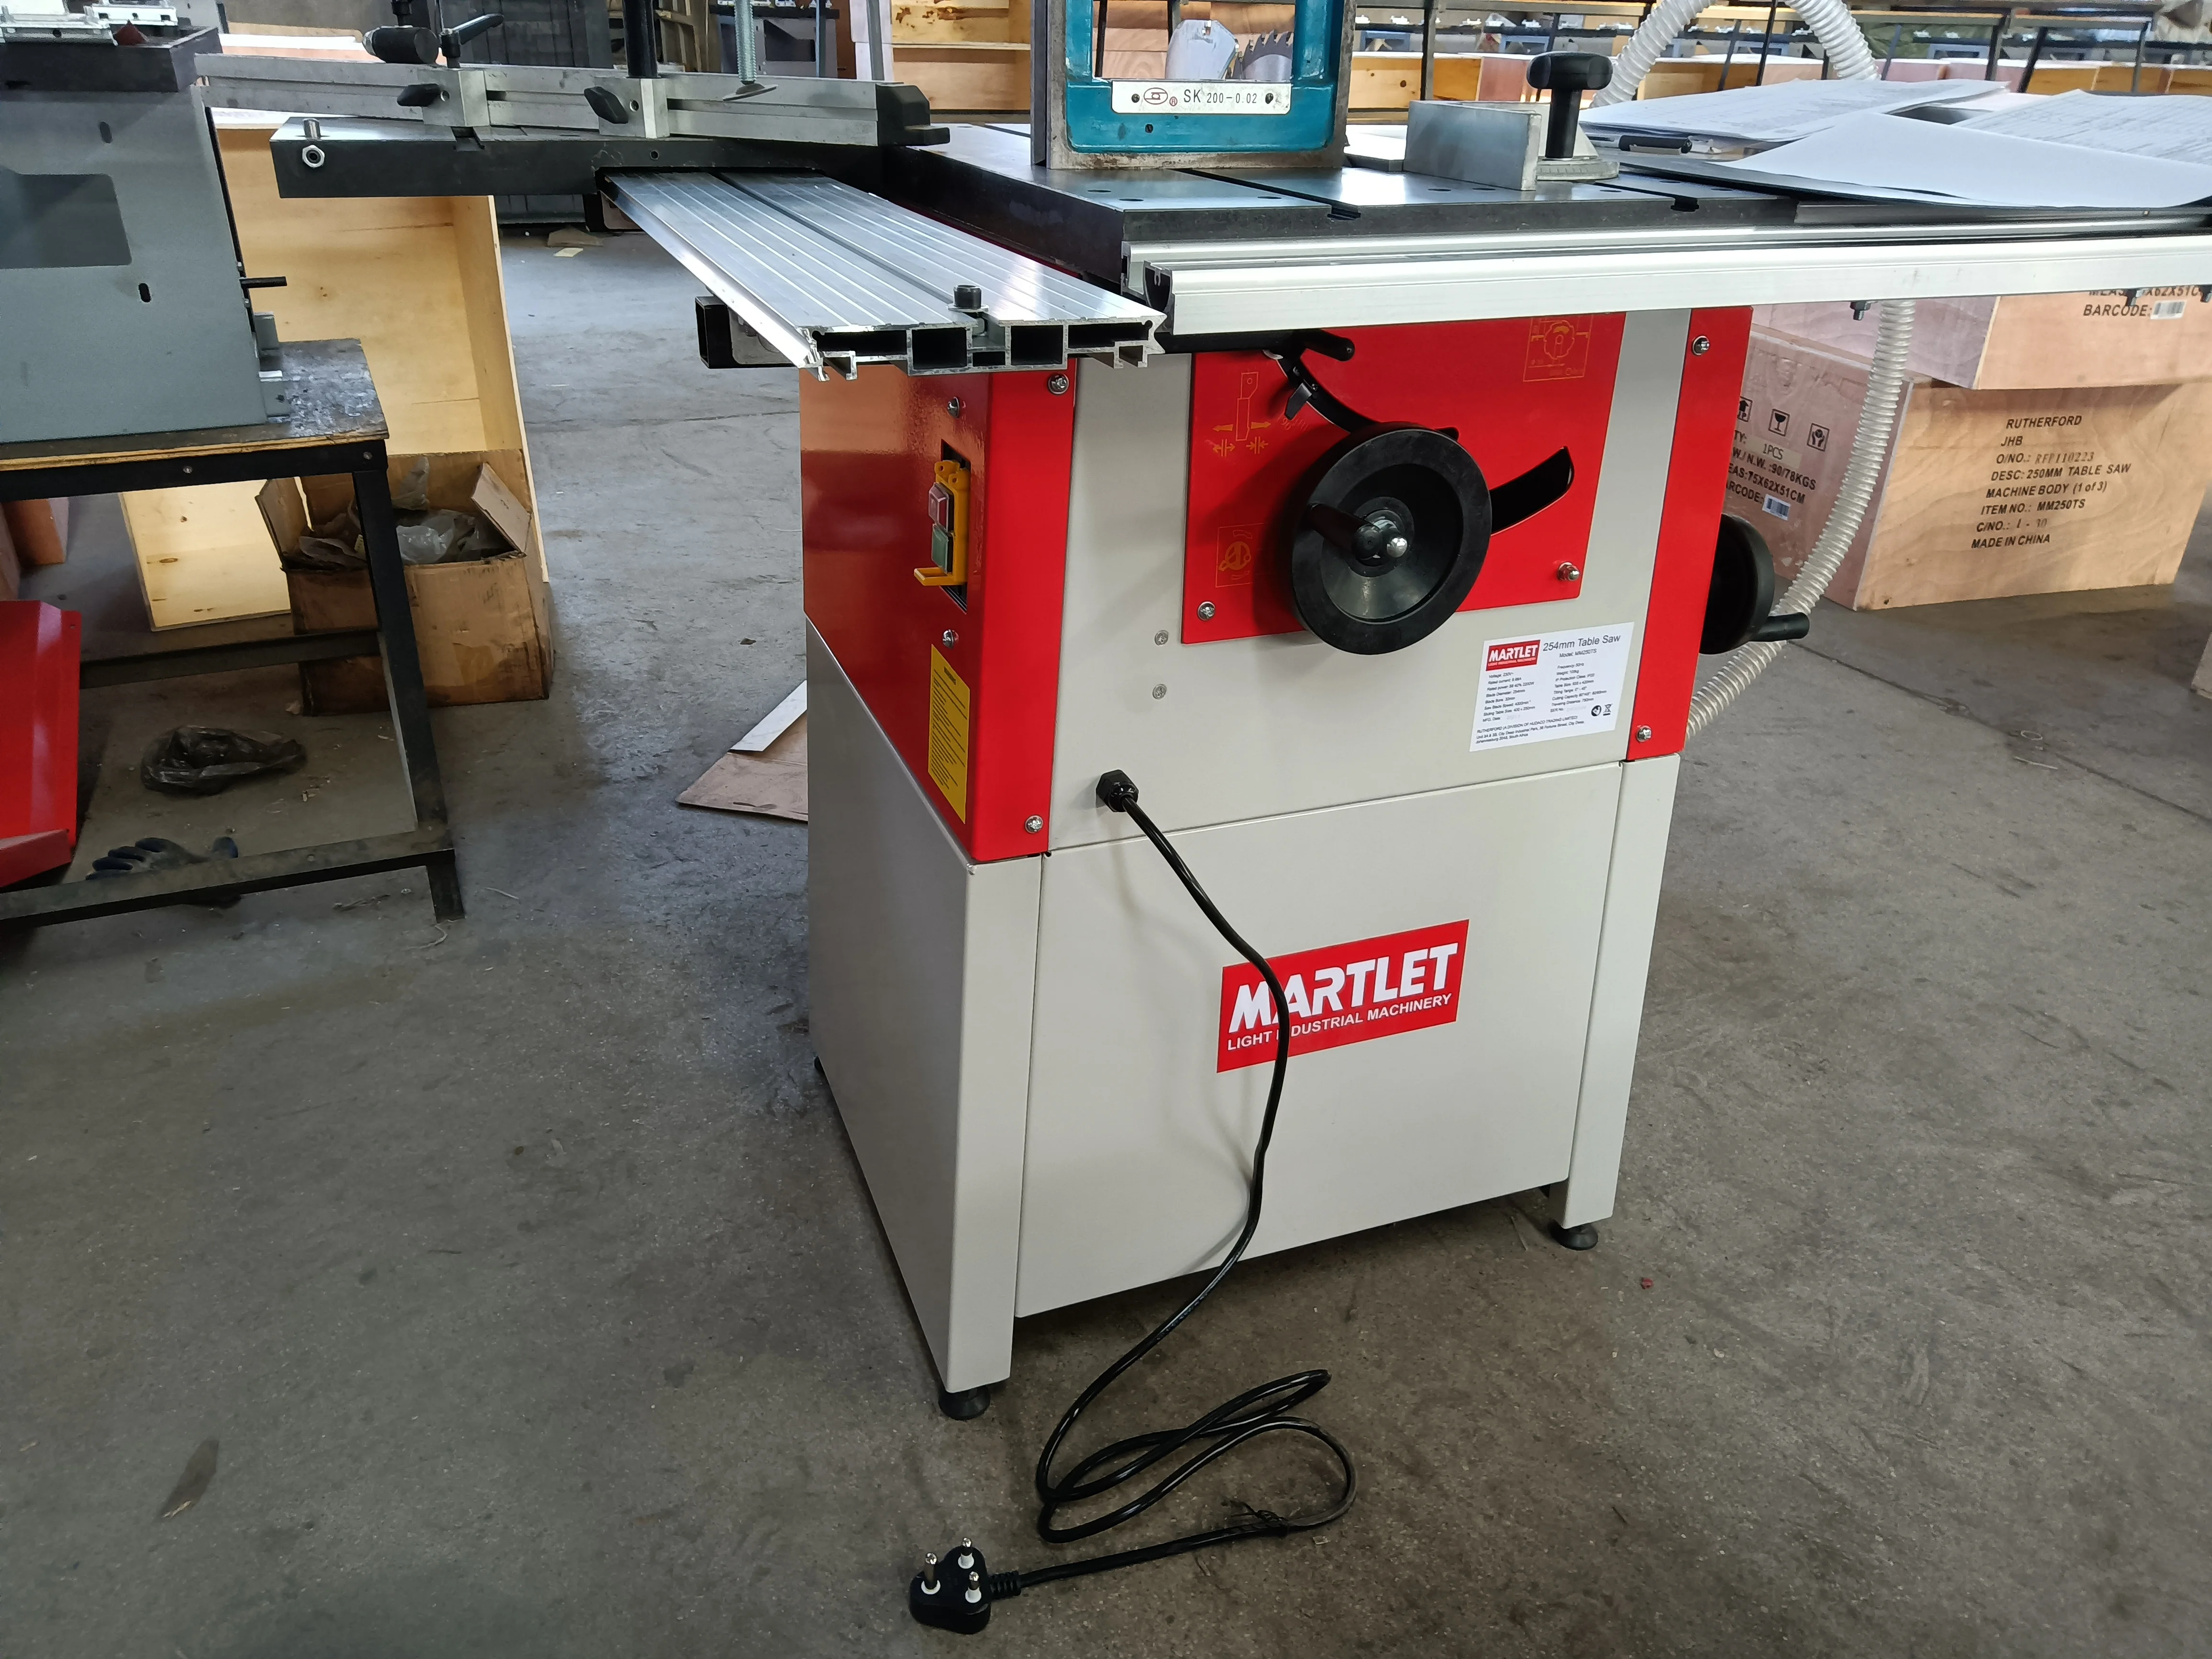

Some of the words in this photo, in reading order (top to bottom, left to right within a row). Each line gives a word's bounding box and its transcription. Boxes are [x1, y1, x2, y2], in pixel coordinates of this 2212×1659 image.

[1183, 89, 1201, 103] SK
[2083, 304, 2152, 316] BARCODE:
[2006, 415, 2082, 429] RUTHERFORD
[1734, 430, 1747, 444] TY:
[2001, 436, 2023, 447] JHB
[1763, 443, 1784, 460] 1PCS
[1991, 470, 2025, 481] DESC:
[2026, 467, 2063, 479] 250MM
[2068, 465, 2102, 476] TABLE
[2106, 463, 2132, 474] SAW
[1726, 480, 1765, 504] RCODE:
[1728, 463, 1806, 504] EAS:75X62X51CM
[1986, 486, 2036, 498] MACHINE
[2038, 483, 2069, 495] BODY
[2085, 481, 2096, 492] of
[1981, 504, 2007, 515] ITEM
[2036, 498, 2086, 511] MM250TS
[1971, 536, 2003, 548] MADE
[2004, 536, 2016, 546] IN
[2018, 534, 2050, 545] CHINA
[1543, 641, 1575, 652] 254mm
[1578, 636, 1600, 647] Table
[1602, 634, 1621, 643] Saw
[1488, 644, 1538, 662] MARTLET
[1228, 942, 1459, 1033] MARTLET
[1228, 1030, 1273, 1051] LIGHT
[1276, 1012, 1363, 1040] IDUSTRIAL
[1367, 993, 1452, 1021] MACHINERY
